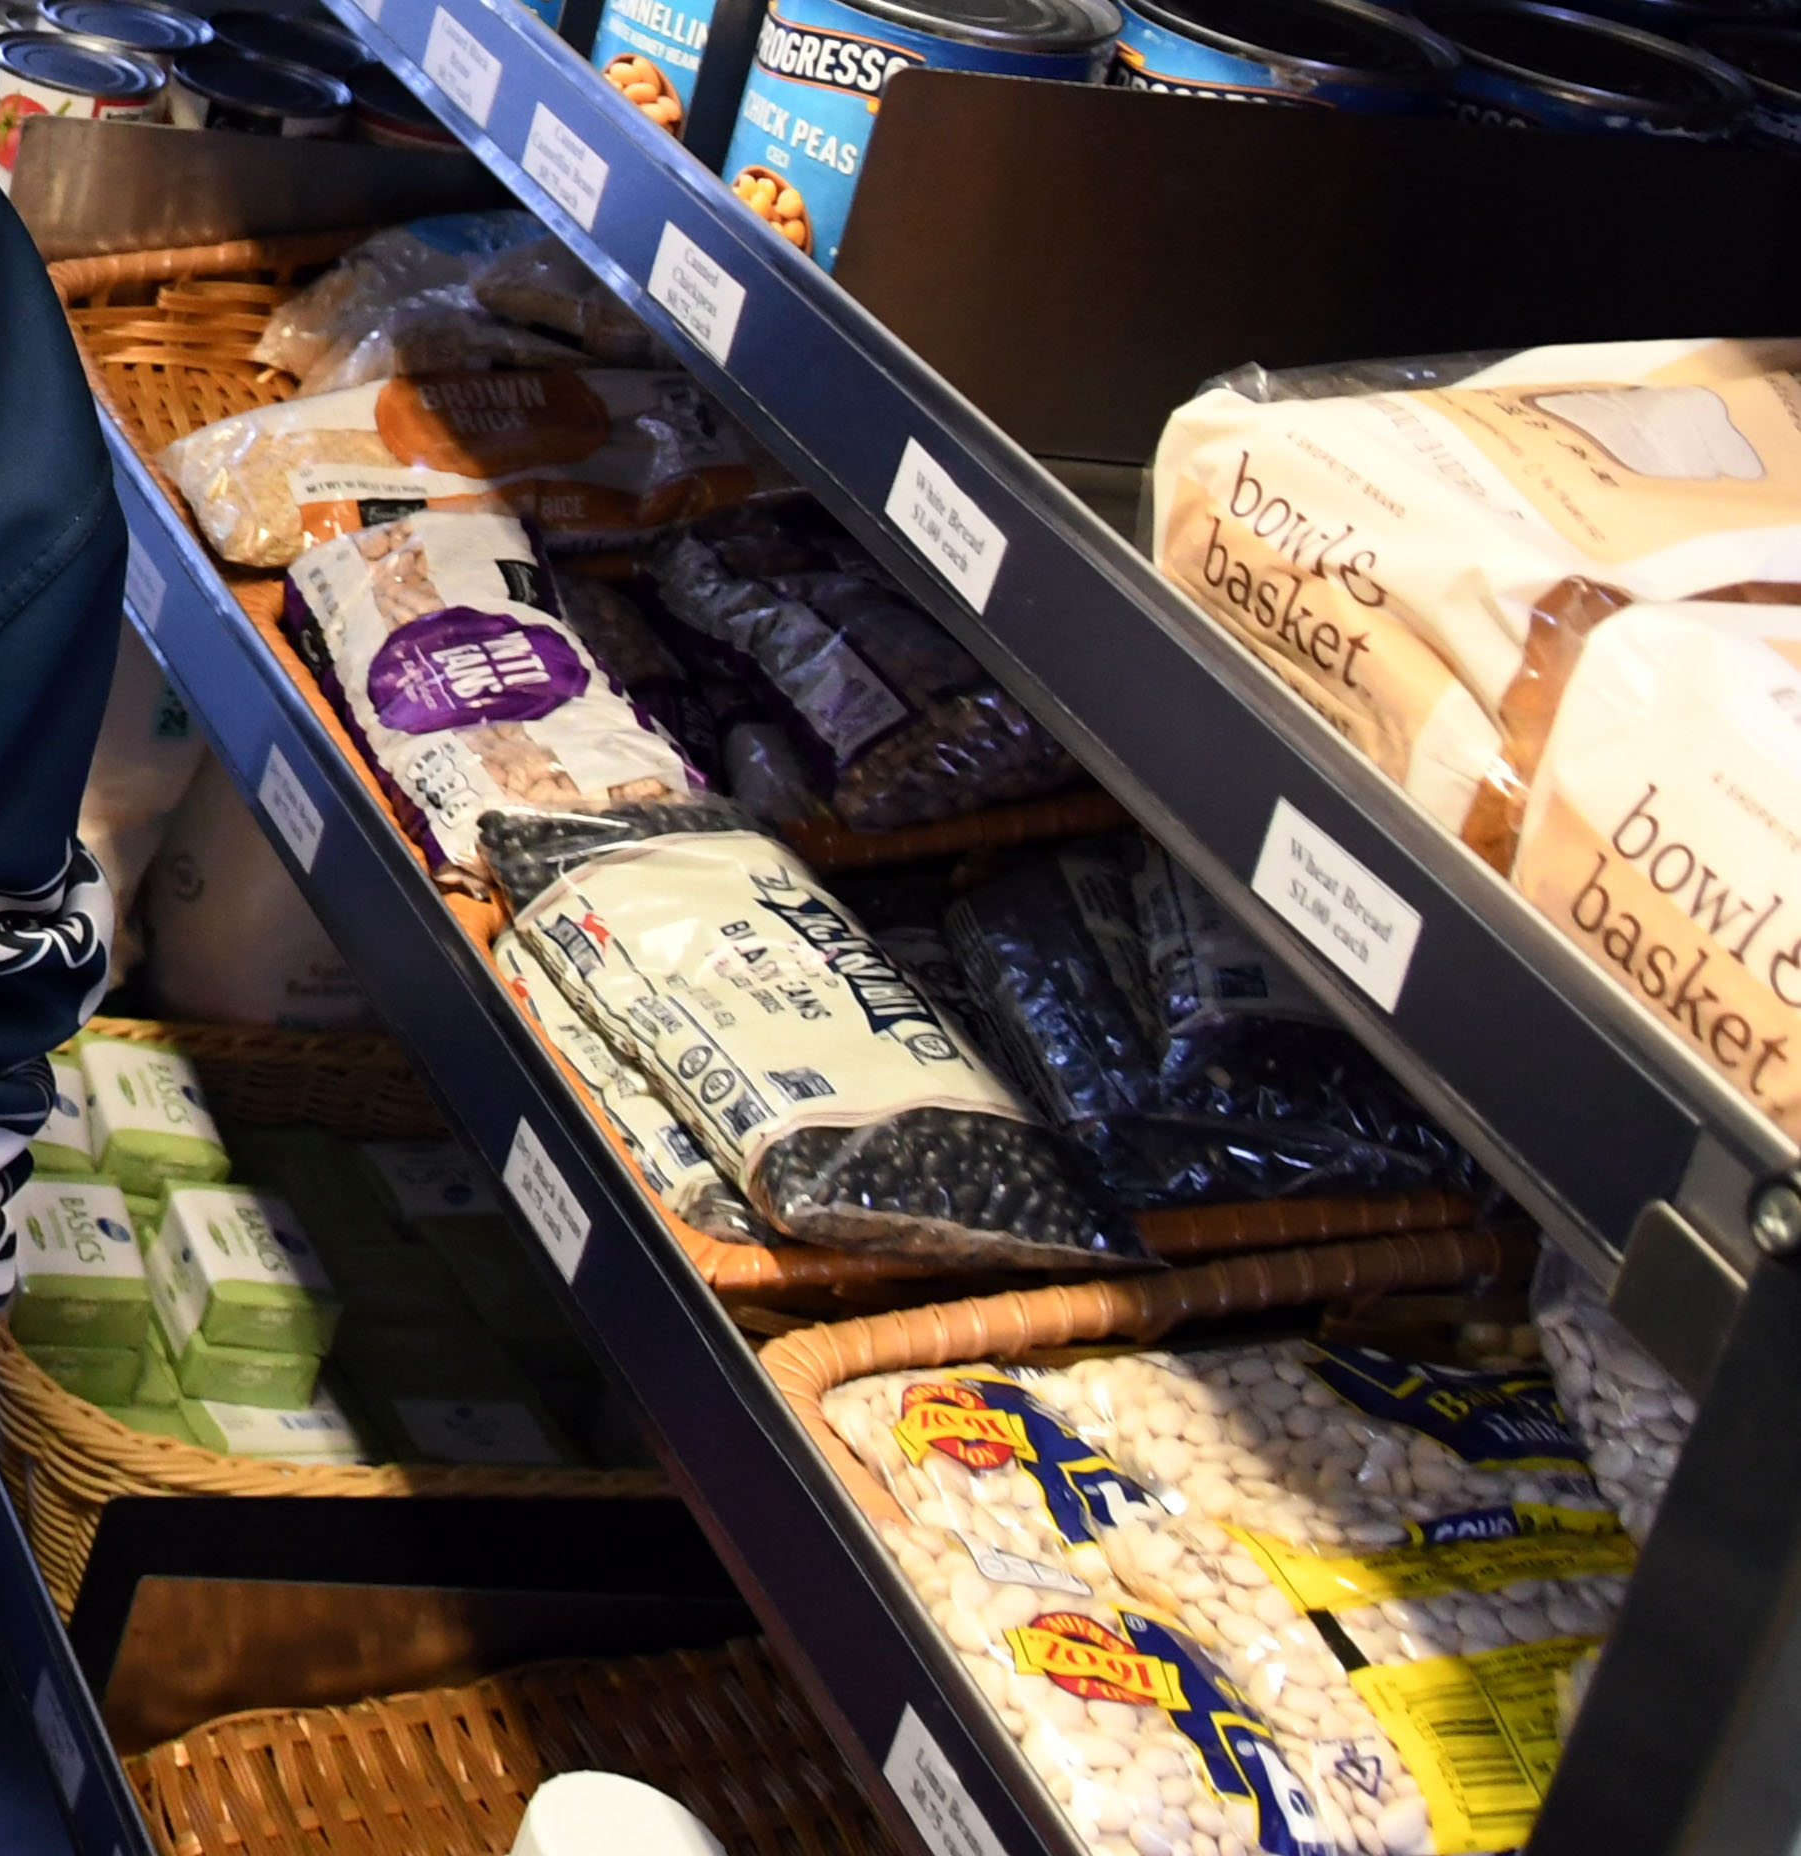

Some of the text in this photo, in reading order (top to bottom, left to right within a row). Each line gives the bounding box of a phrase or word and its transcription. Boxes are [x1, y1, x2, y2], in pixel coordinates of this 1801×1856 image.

[790, 116, 859, 176] PEAS
[1201, 517, 1372, 691] basket
[1289, 836, 1395, 944] Wheat Bread
[1331, 918, 1371, 966] each
[1570, 851, 1791, 1098] basket
[148, 1060, 192, 1125] BASICS
[58, 1195, 106, 1265] BASICS
[234, 1205, 290, 1274] BASICS
